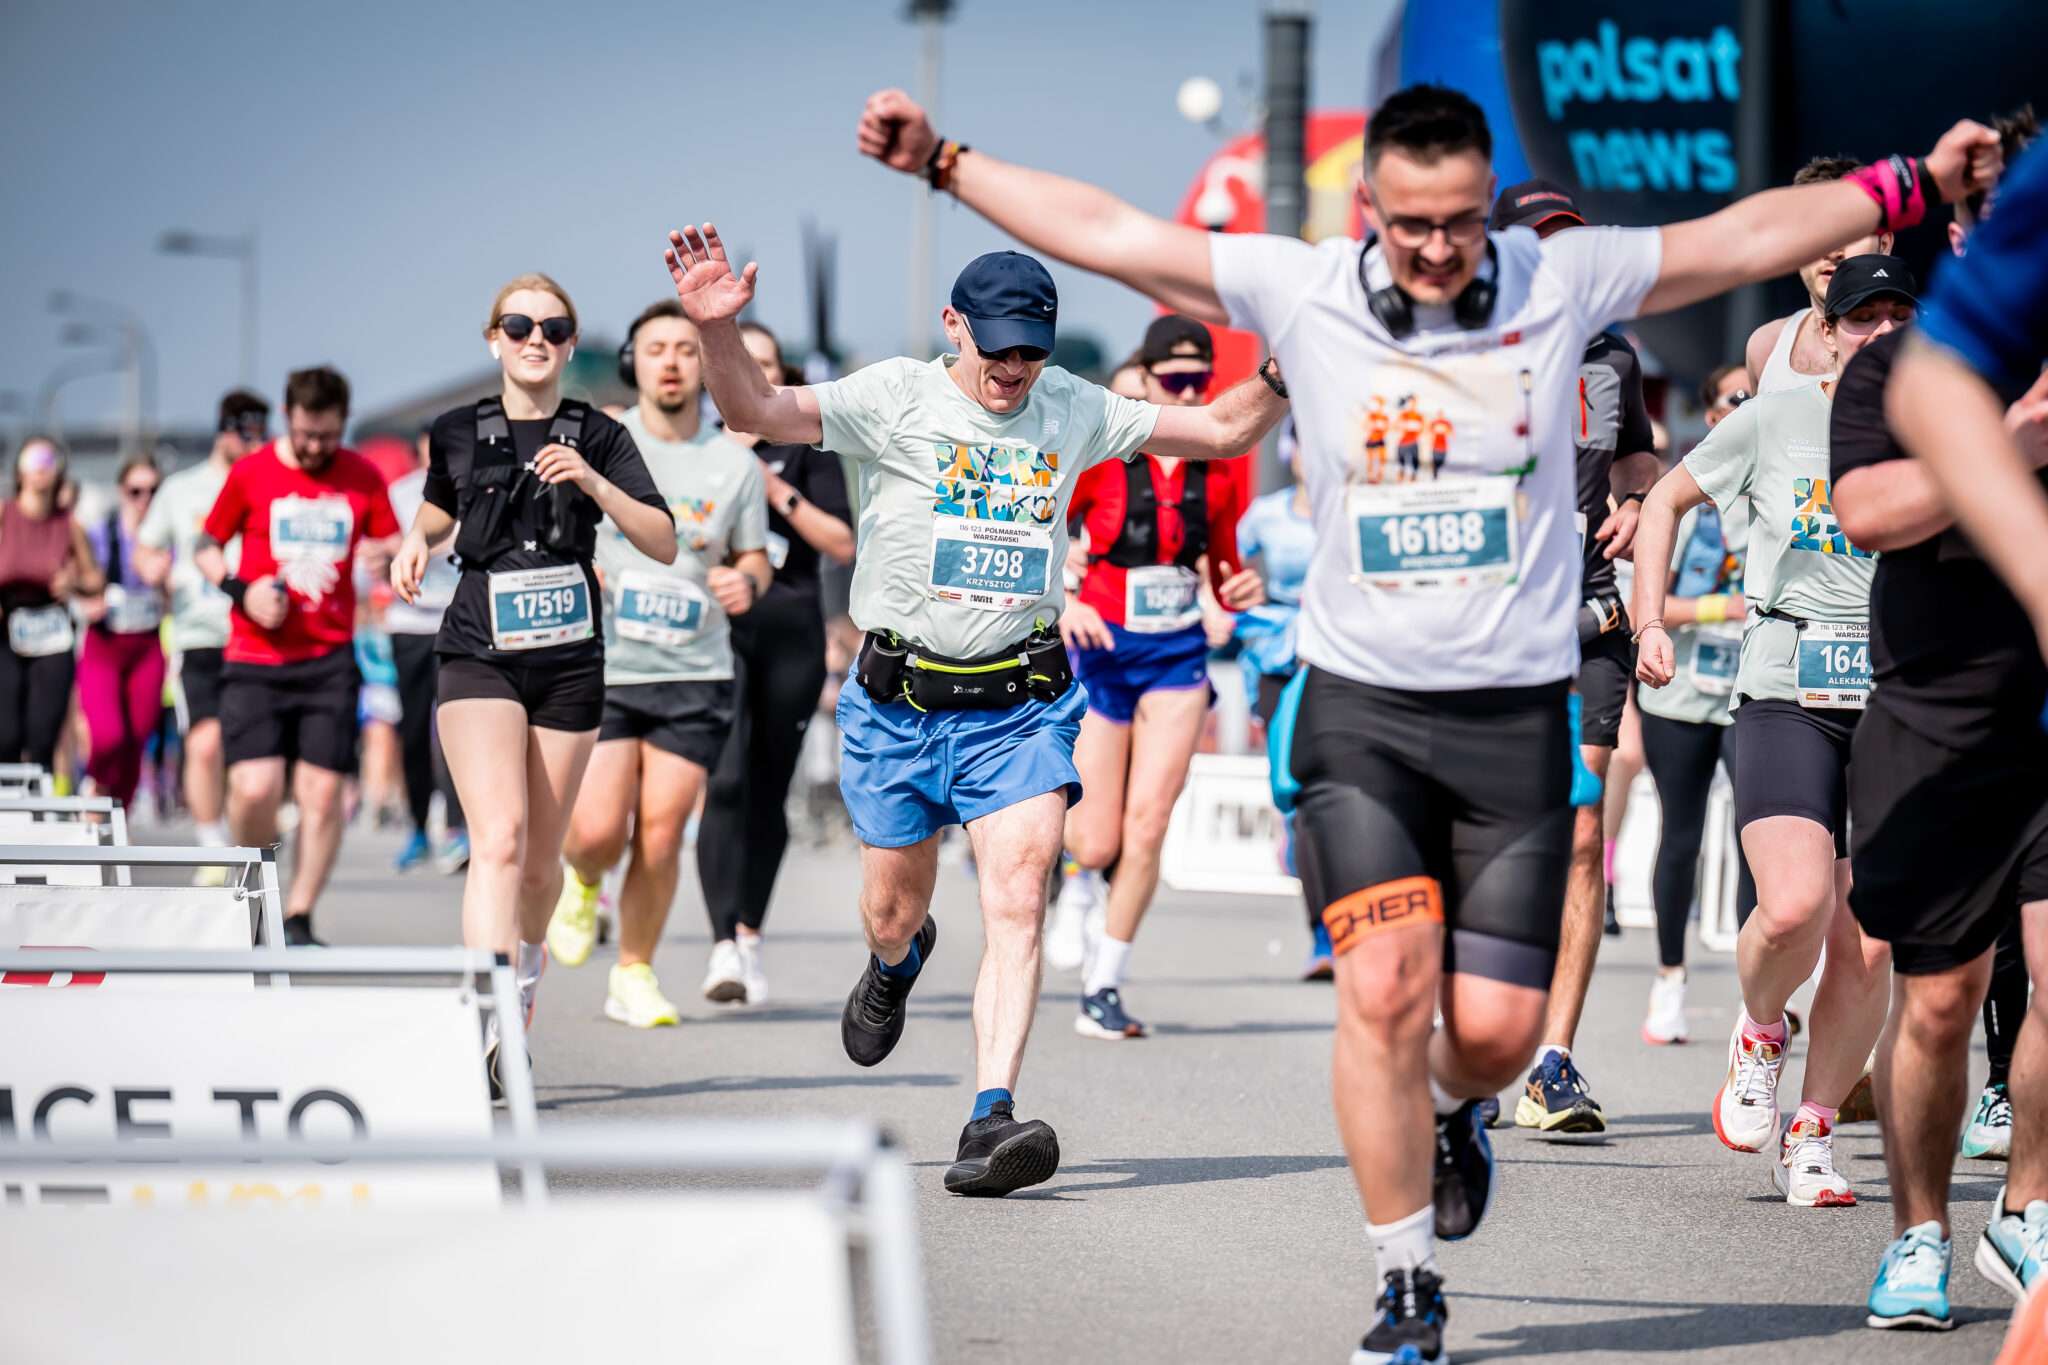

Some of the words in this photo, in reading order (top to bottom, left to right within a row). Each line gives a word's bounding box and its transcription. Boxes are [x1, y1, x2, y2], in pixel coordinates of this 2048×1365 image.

[1537, 18, 1742, 121] polsat
[1568, 129, 1738, 193] news
[973, 533, 1019, 543] WARSZAWSKI
[1381, 511, 1486, 556] 16188
[961, 545, 1024, 578] 3798
[966, 577, 1016, 590] KRZYSZTOF
[513, 588, 575, 619] 17519
[1820, 645, 1874, 674] 164
[212, 1089, 368, 1165] TO
